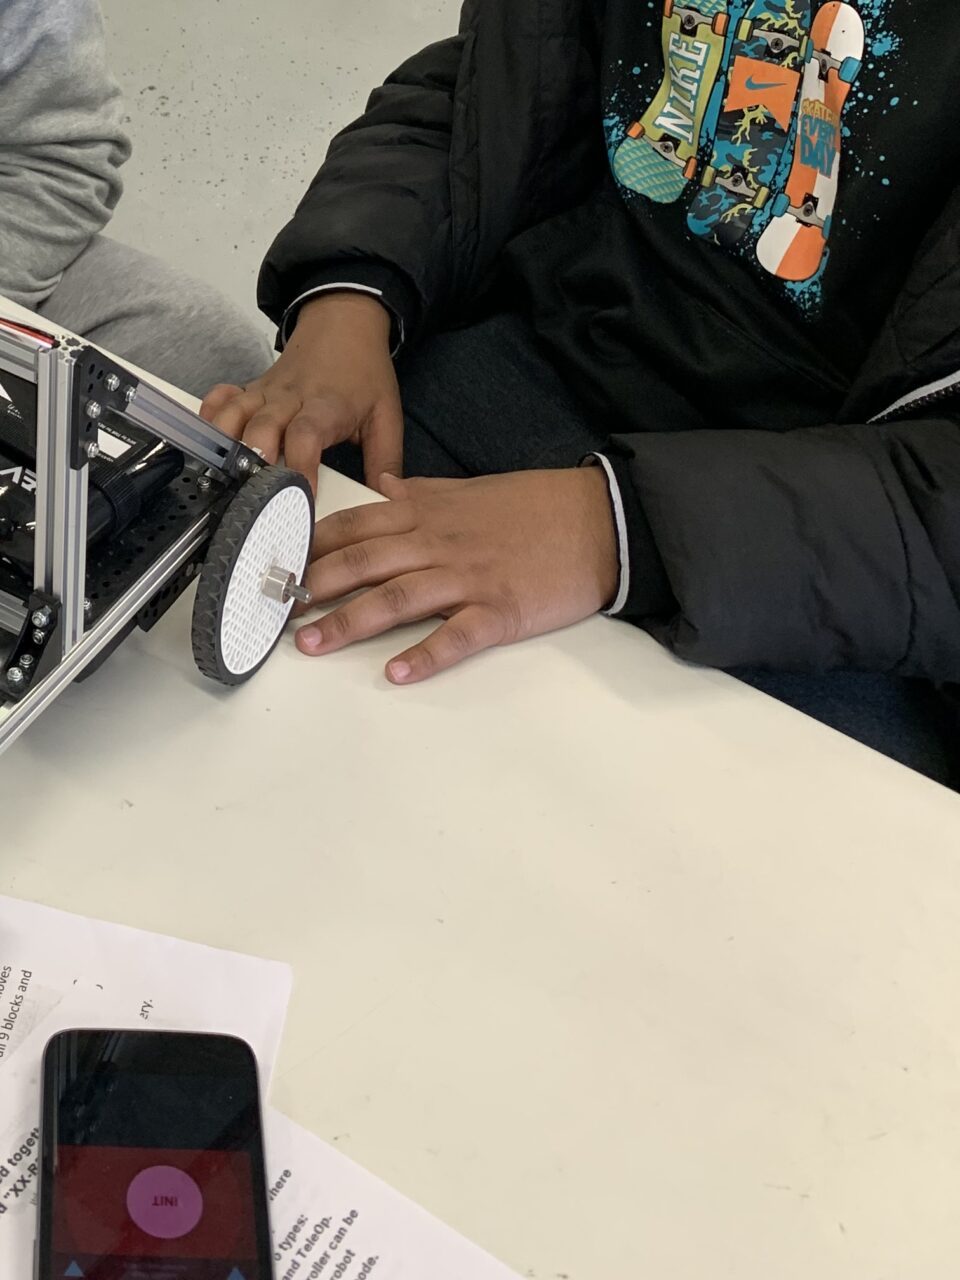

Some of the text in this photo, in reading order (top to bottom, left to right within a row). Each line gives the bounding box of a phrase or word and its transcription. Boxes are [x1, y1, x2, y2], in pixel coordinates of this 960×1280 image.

[654, 33, 709, 145] NIKE
[0, 994, 24, 1031] blocks
[17, 969, 33, 993] and
[151, 1195, 179, 1208] INIT
[281, 1214, 309, 1252] types:
[295, 1216, 333, 1259] TeleOp.
[328, 1226, 348, 1251] can
[341, 1209, 359, 1226] be
